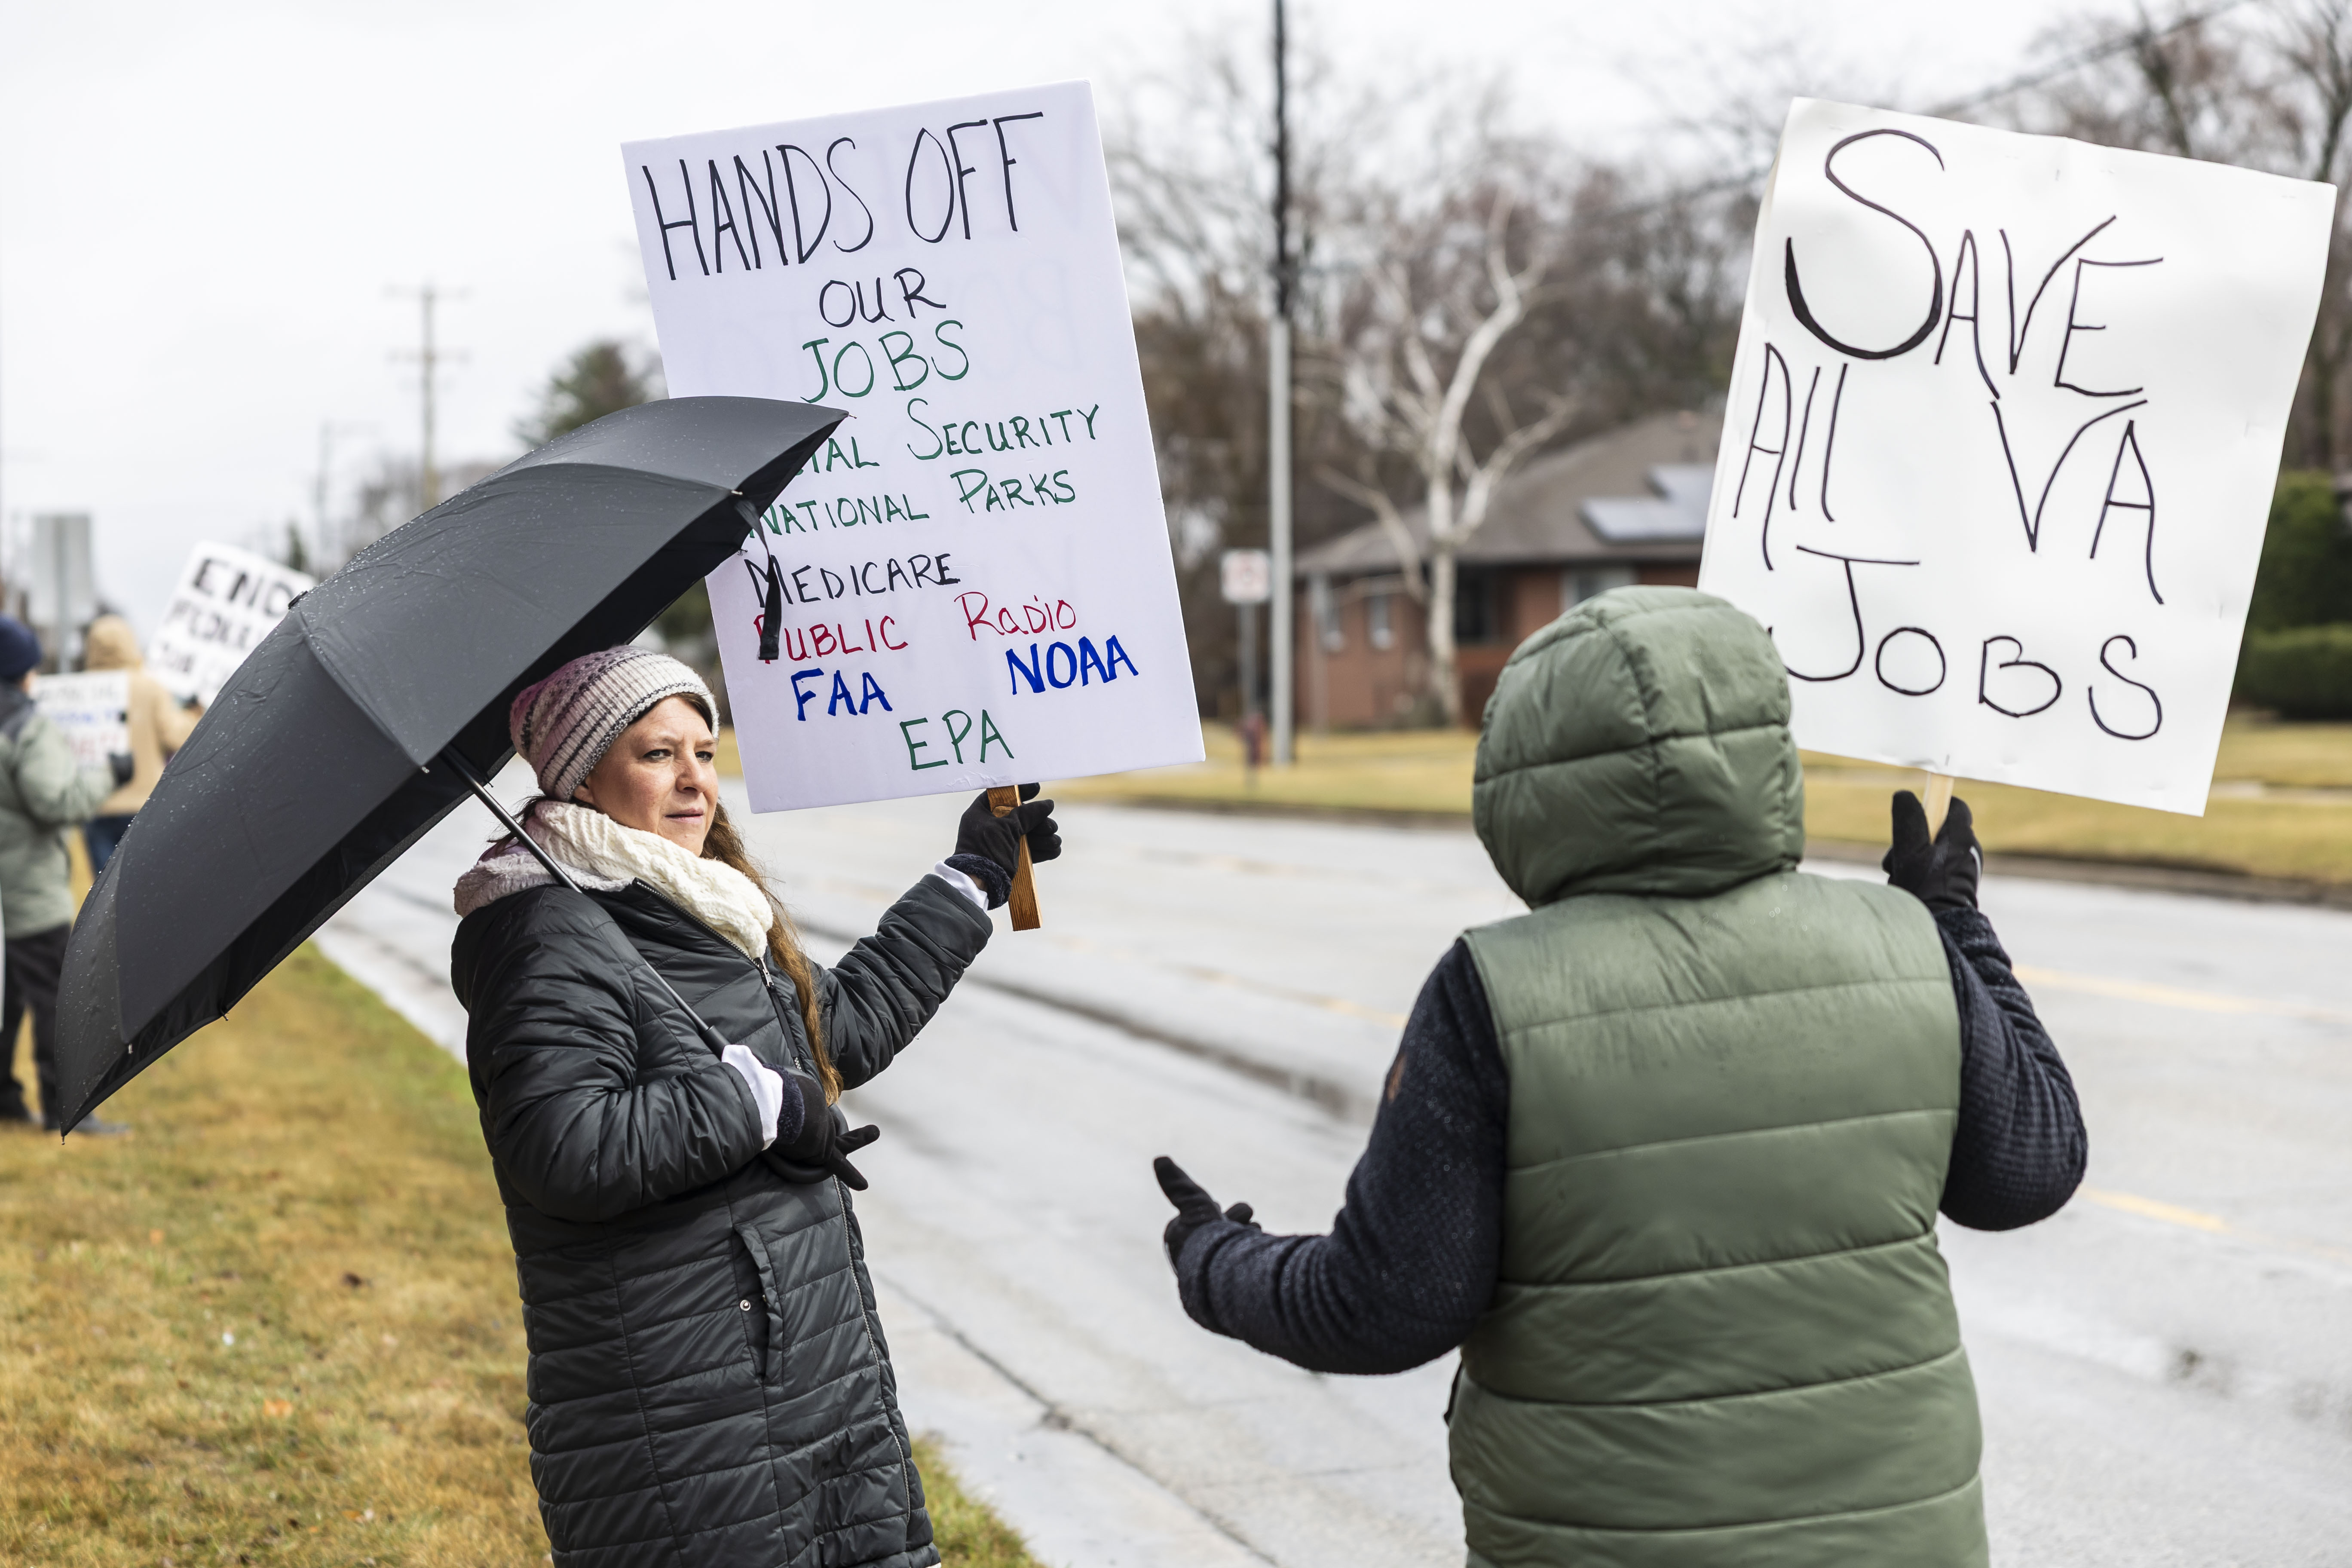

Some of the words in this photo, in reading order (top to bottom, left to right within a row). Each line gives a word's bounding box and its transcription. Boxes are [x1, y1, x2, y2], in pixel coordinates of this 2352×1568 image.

[642, 138, 873, 280] HANDS
[906, 112, 1043, 243] OFF
[820, 268, 946, 328] OUR
[1785, 128, 2165, 399] SAVE
[800, 319, 969, 403] JOBS
[907, 398, 1099, 460] SECURITY
[950, 469, 1075, 513] PARKS
[1991, 399, 2165, 605] VA
[744, 554, 960, 608] MEDICARE
[791, 668, 892, 721] FAA
[1006, 635, 1139, 695] NOAA
[1768, 545, 2163, 740] JOBS
[900, 710, 1014, 770] EPA
